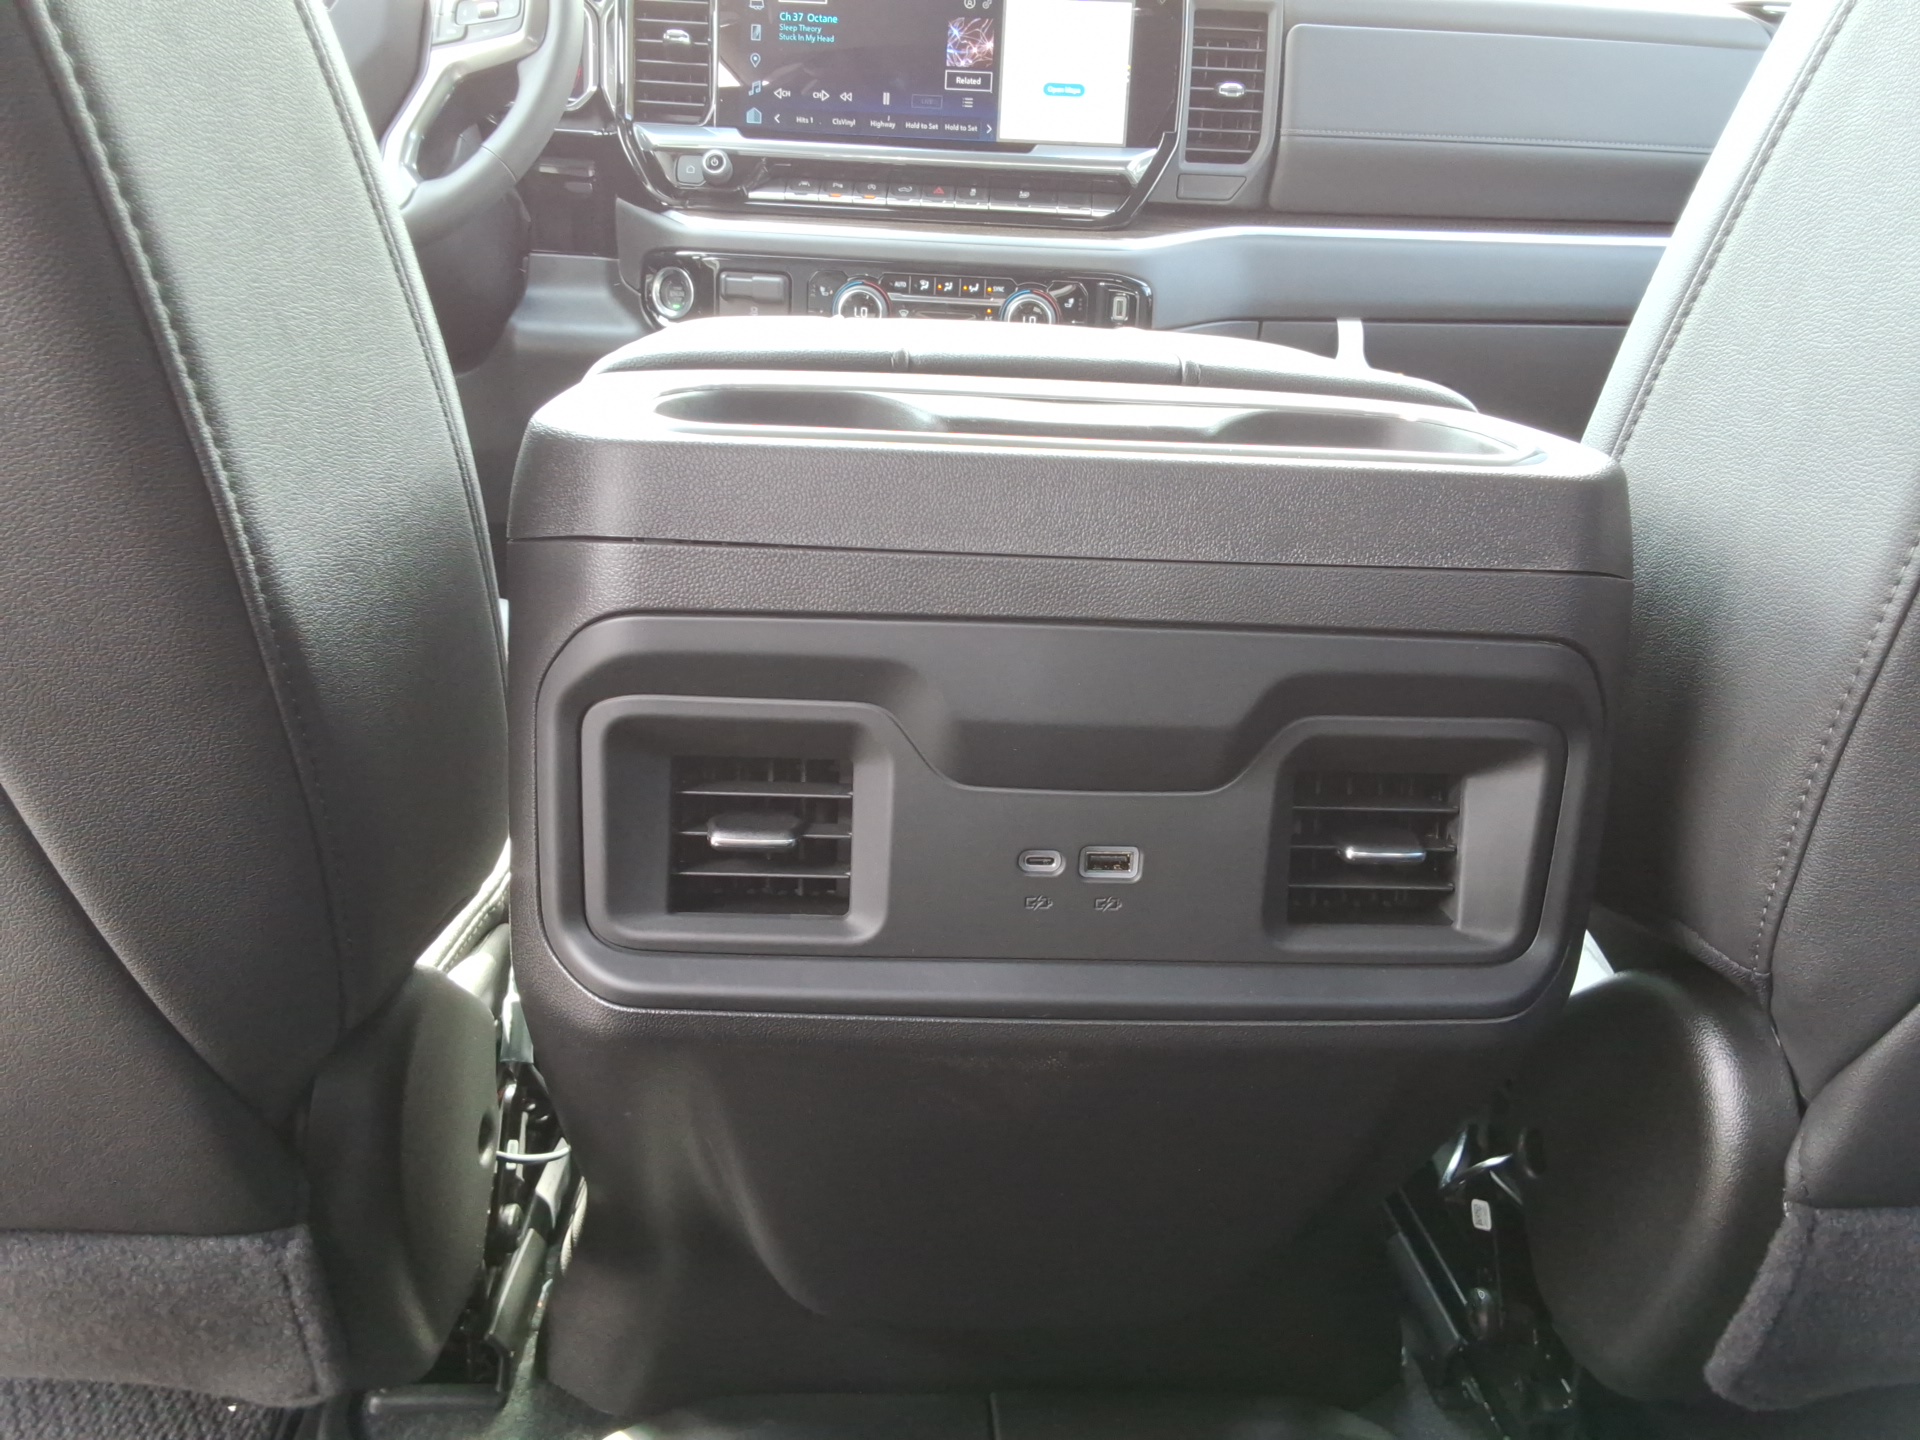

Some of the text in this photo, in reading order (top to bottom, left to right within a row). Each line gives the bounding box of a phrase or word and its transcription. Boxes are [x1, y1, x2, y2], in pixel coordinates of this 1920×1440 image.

[779, 11, 838, 23] Ch 37 Octane
[779, 24, 822, 34] Sleep Theory
[779, 33, 797, 41] Stuck
[805, 34, 816, 43] My
[956, 76, 981, 85] Related
[870, 120, 896, 130] Highway
[905, 121, 939, 130] Hold to Set
[944, 123, 959, 131] Hold
[967, 124, 978, 132] Set
[854, 306, 868, 318] LO
